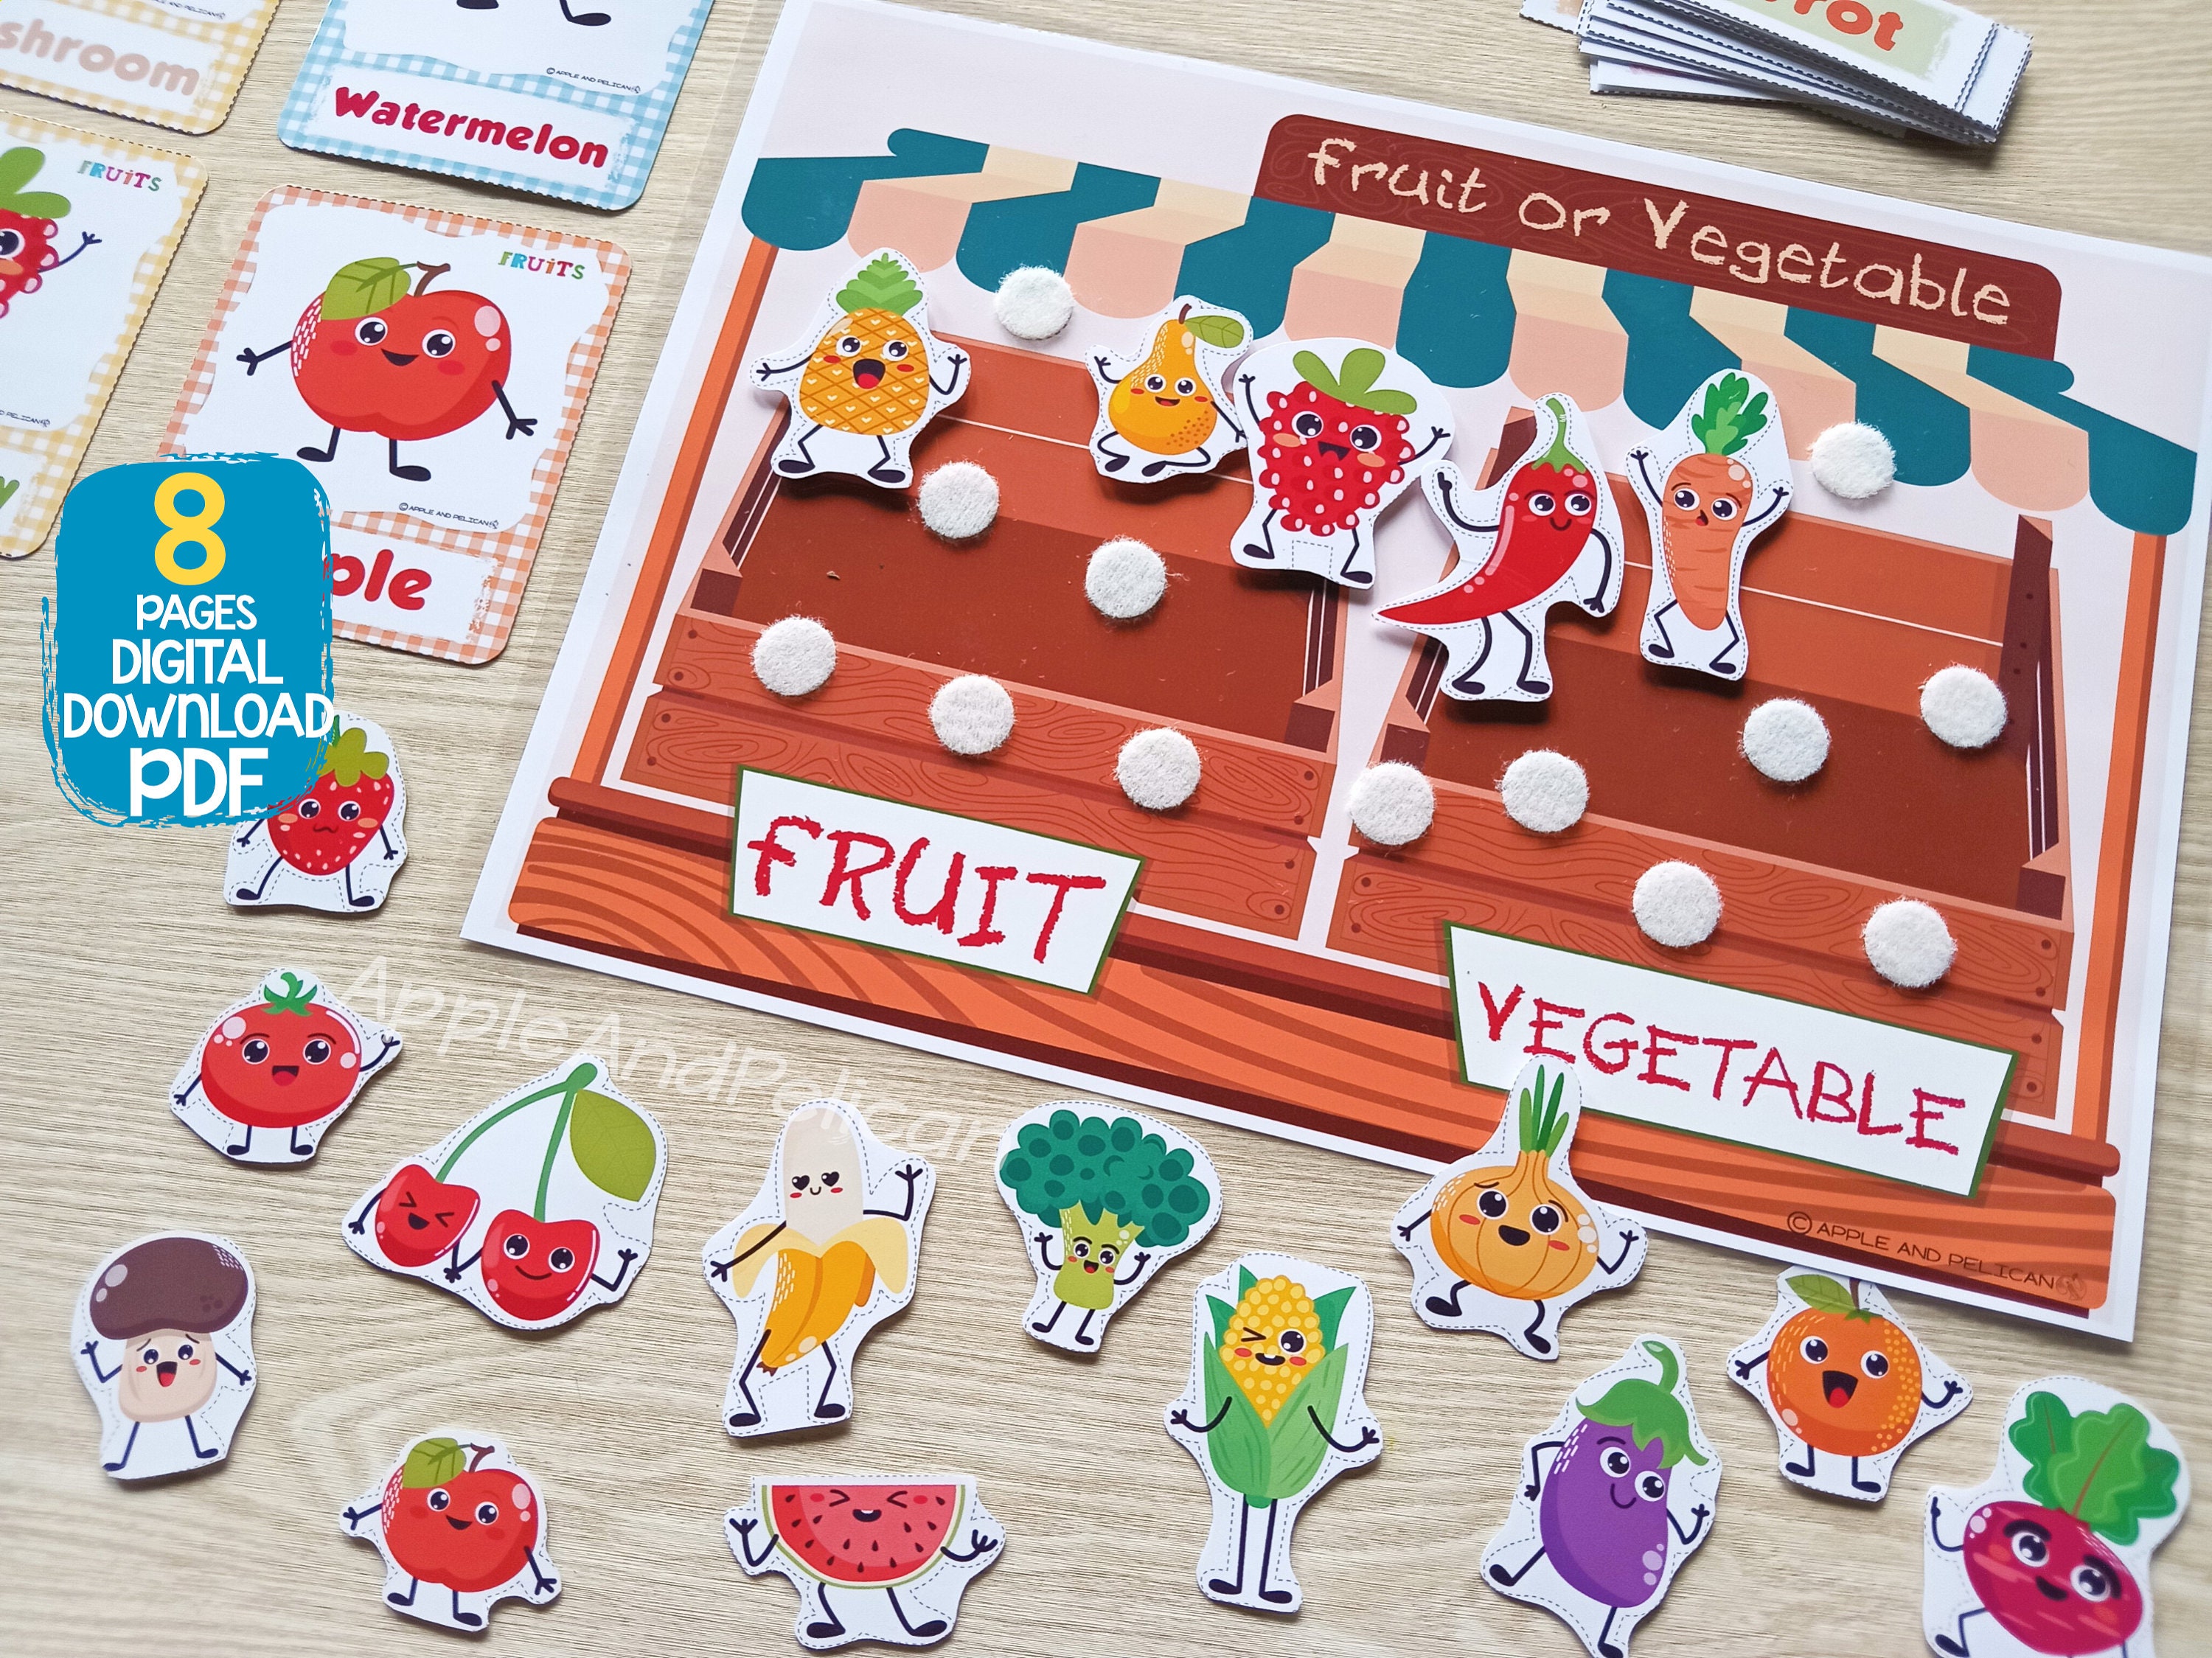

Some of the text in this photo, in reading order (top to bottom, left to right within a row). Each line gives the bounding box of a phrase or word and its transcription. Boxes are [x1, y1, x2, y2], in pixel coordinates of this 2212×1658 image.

[556, 70, 580, 79] APPLE
[597, 79, 631, 91] PELICAN
[335, 87, 608, 168] Watermelon
[1644, 197, 2011, 325] Vegetable
[408, 505, 435, 515] APPLE
[436, 511, 452, 519] AND
[453, 514, 490, 526] PELICAN
[747, 815, 1107, 964] FRUIT
[1478, 980, 1966, 1157] VEGETABLE
[1817, 1222, 1891, 1251] APPLE
[1897, 1241, 1942, 1263] AND
[1948, 1253, 2055, 1290] PELICAN
